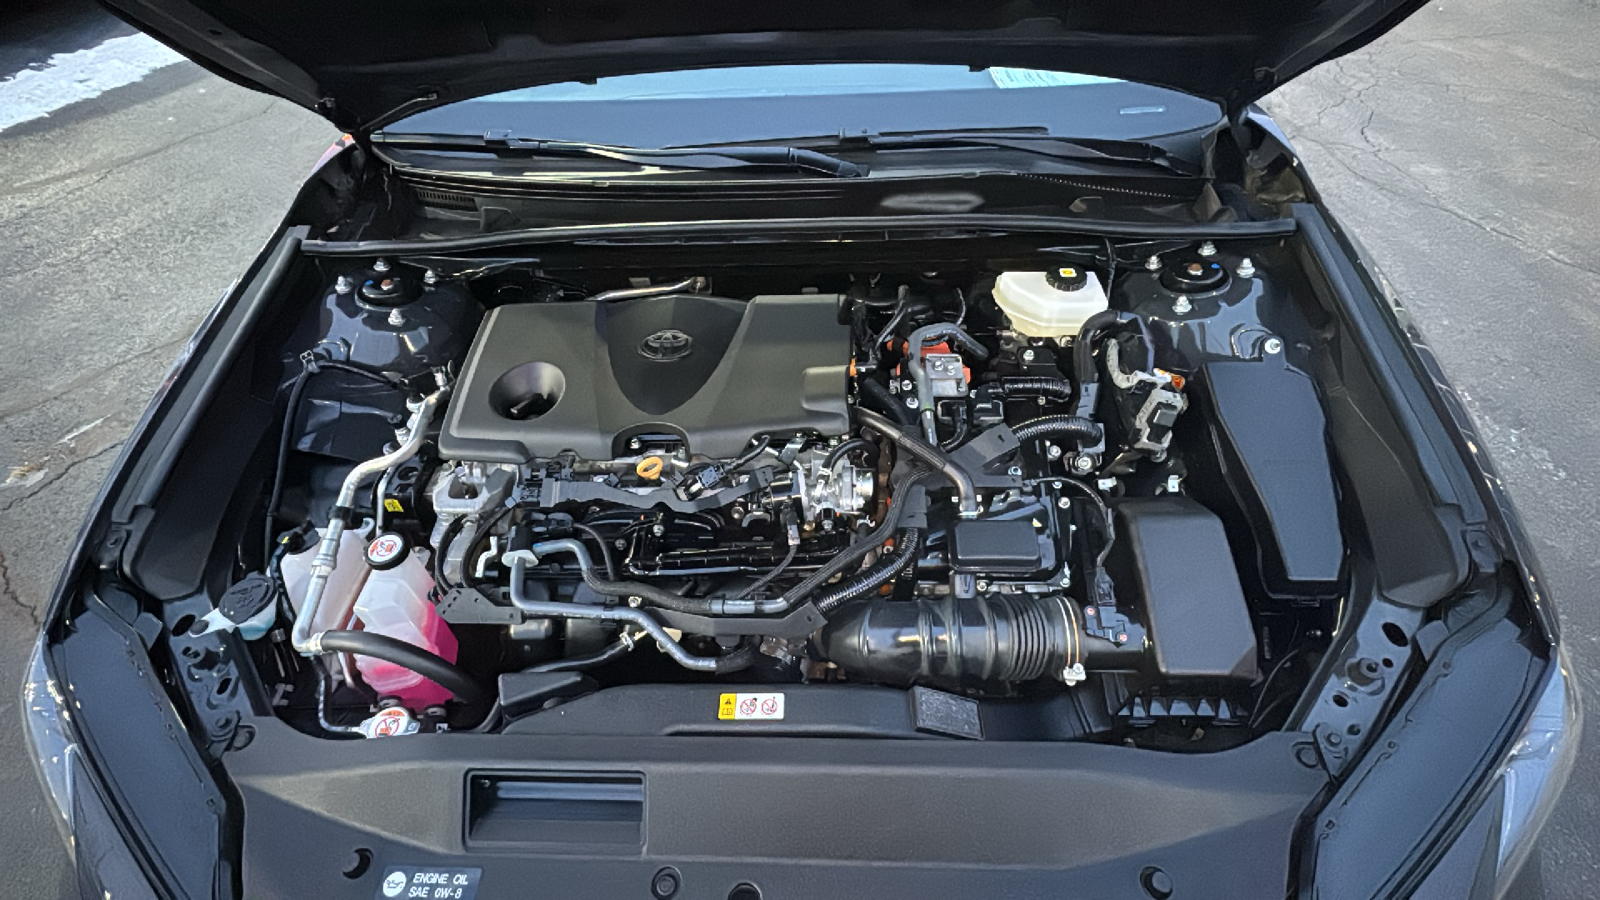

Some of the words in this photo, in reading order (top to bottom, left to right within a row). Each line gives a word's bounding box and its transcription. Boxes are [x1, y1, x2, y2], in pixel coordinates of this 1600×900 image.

[413, 873, 449, 884] ENGINE
[453, 874, 469, 885] OIL
[408, 886, 430, 898] SAE
[434, 887, 463, 899] 0W-8
